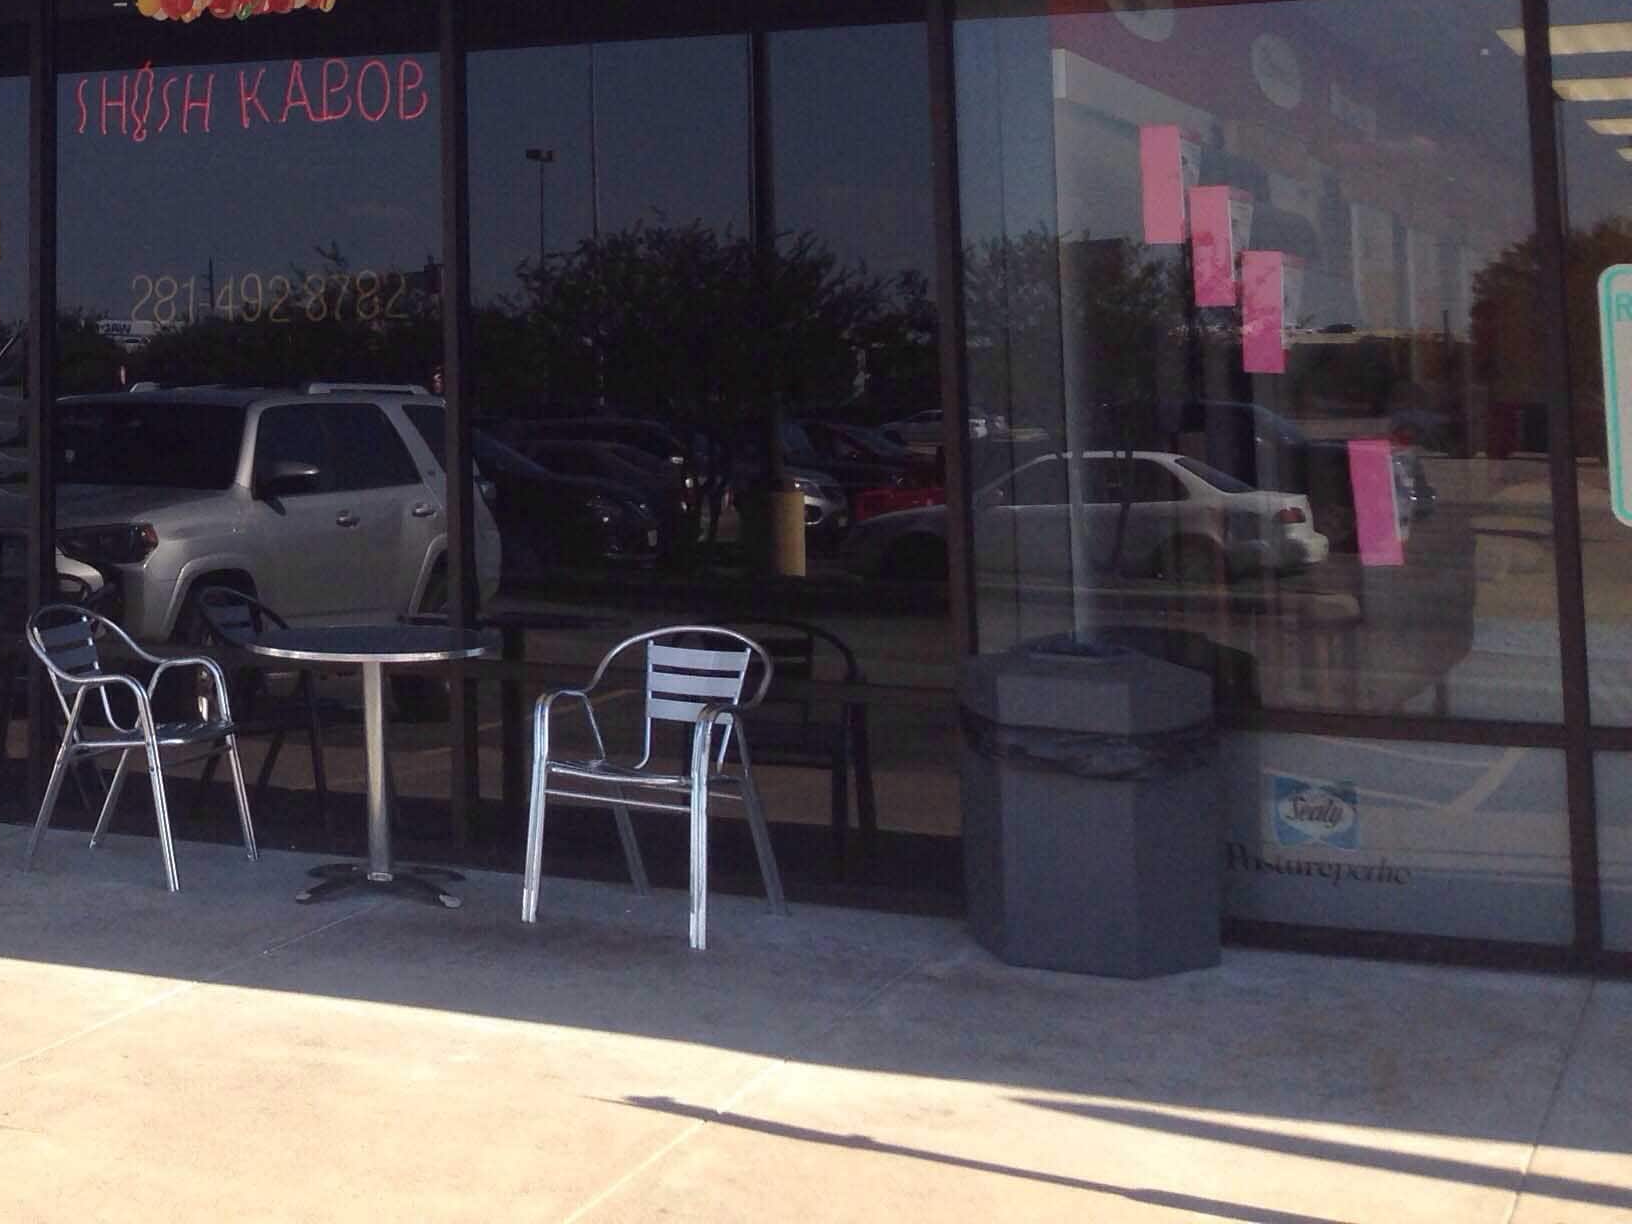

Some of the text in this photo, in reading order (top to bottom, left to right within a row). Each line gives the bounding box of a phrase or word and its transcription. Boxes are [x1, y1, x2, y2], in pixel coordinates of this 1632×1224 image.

[77, 57, 429, 142] SHISH KABOB
[1286, 796, 1345, 828] Sealy
